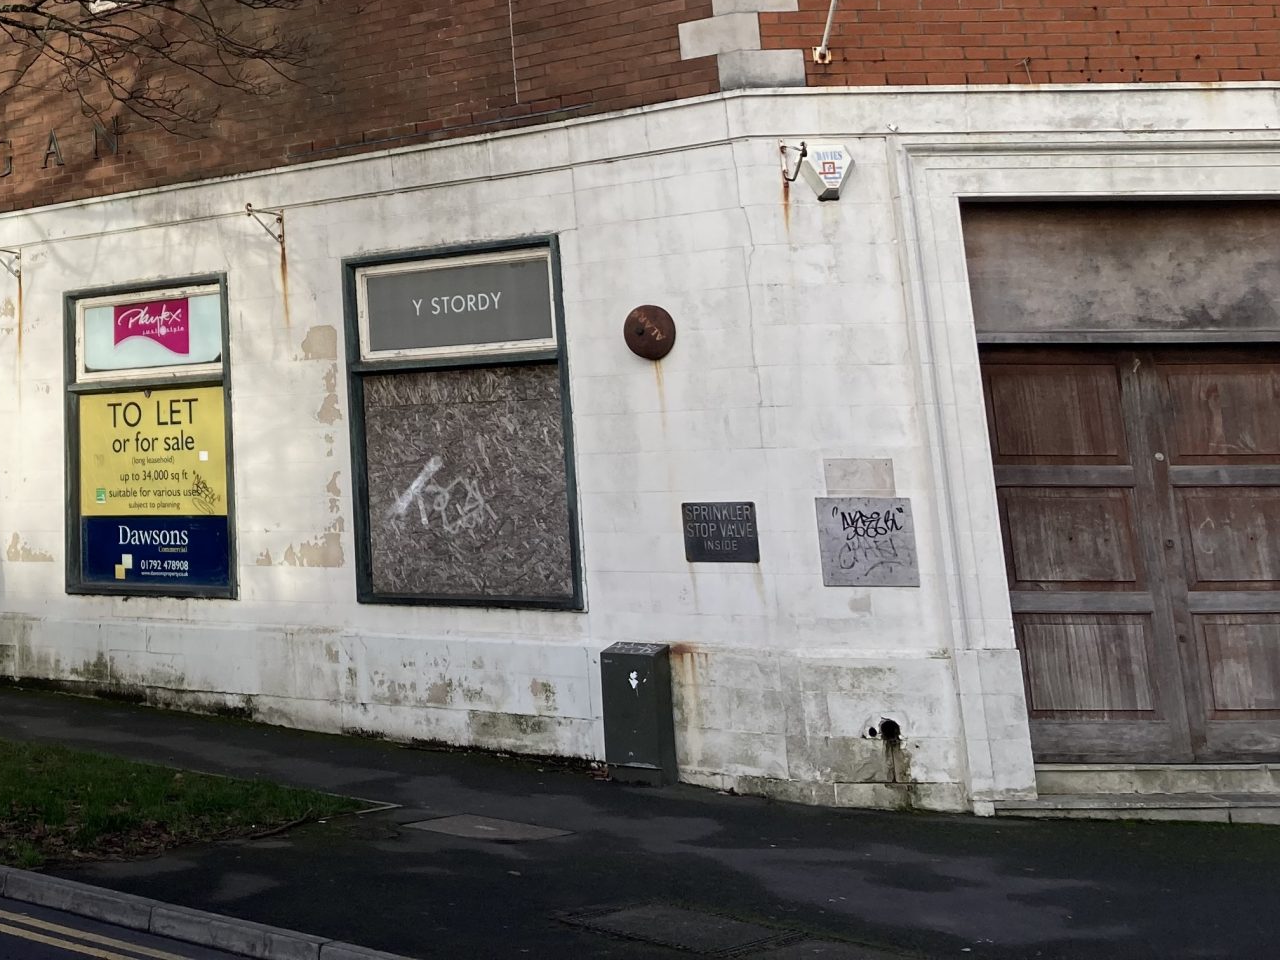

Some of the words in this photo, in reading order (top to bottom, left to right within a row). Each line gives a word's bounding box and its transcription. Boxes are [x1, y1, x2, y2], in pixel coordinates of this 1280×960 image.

[412, 298, 423, 316] Y
[431, 291, 502, 315] STORDY
[118, 304, 182, 337] Playtex
[107, 401, 142, 428] TO
[157, 398, 198, 425] LET
[112, 438, 129, 453] or
[135, 431, 158, 452] for
[164, 430, 195, 451] sale
[132, 457, 146, 466] (long
[120, 472, 130, 483] up
[132, 471, 140, 481] to
[142, 470, 169, 482] 34,000
[171, 471, 180, 483] sq
[182, 469, 188, 480] ft
[109, 487, 137, 498] suitable
[140, 487, 151, 497] for
[153, 487, 181, 497] various
[183, 489, 201, 497] uses
[128, 501, 148, 510] subject
[157, 501, 180, 510] planning
[686, 505, 751, 520] SPRINKLER
[118, 525, 189, 545] Dawsons
[686, 522, 717, 538] STOP
[720, 522, 753, 538] VALVE
[704, 540, 738, 551] INSIDE
[140, 559, 162, 570] 01792
[163, 559, 189, 570] 478908
